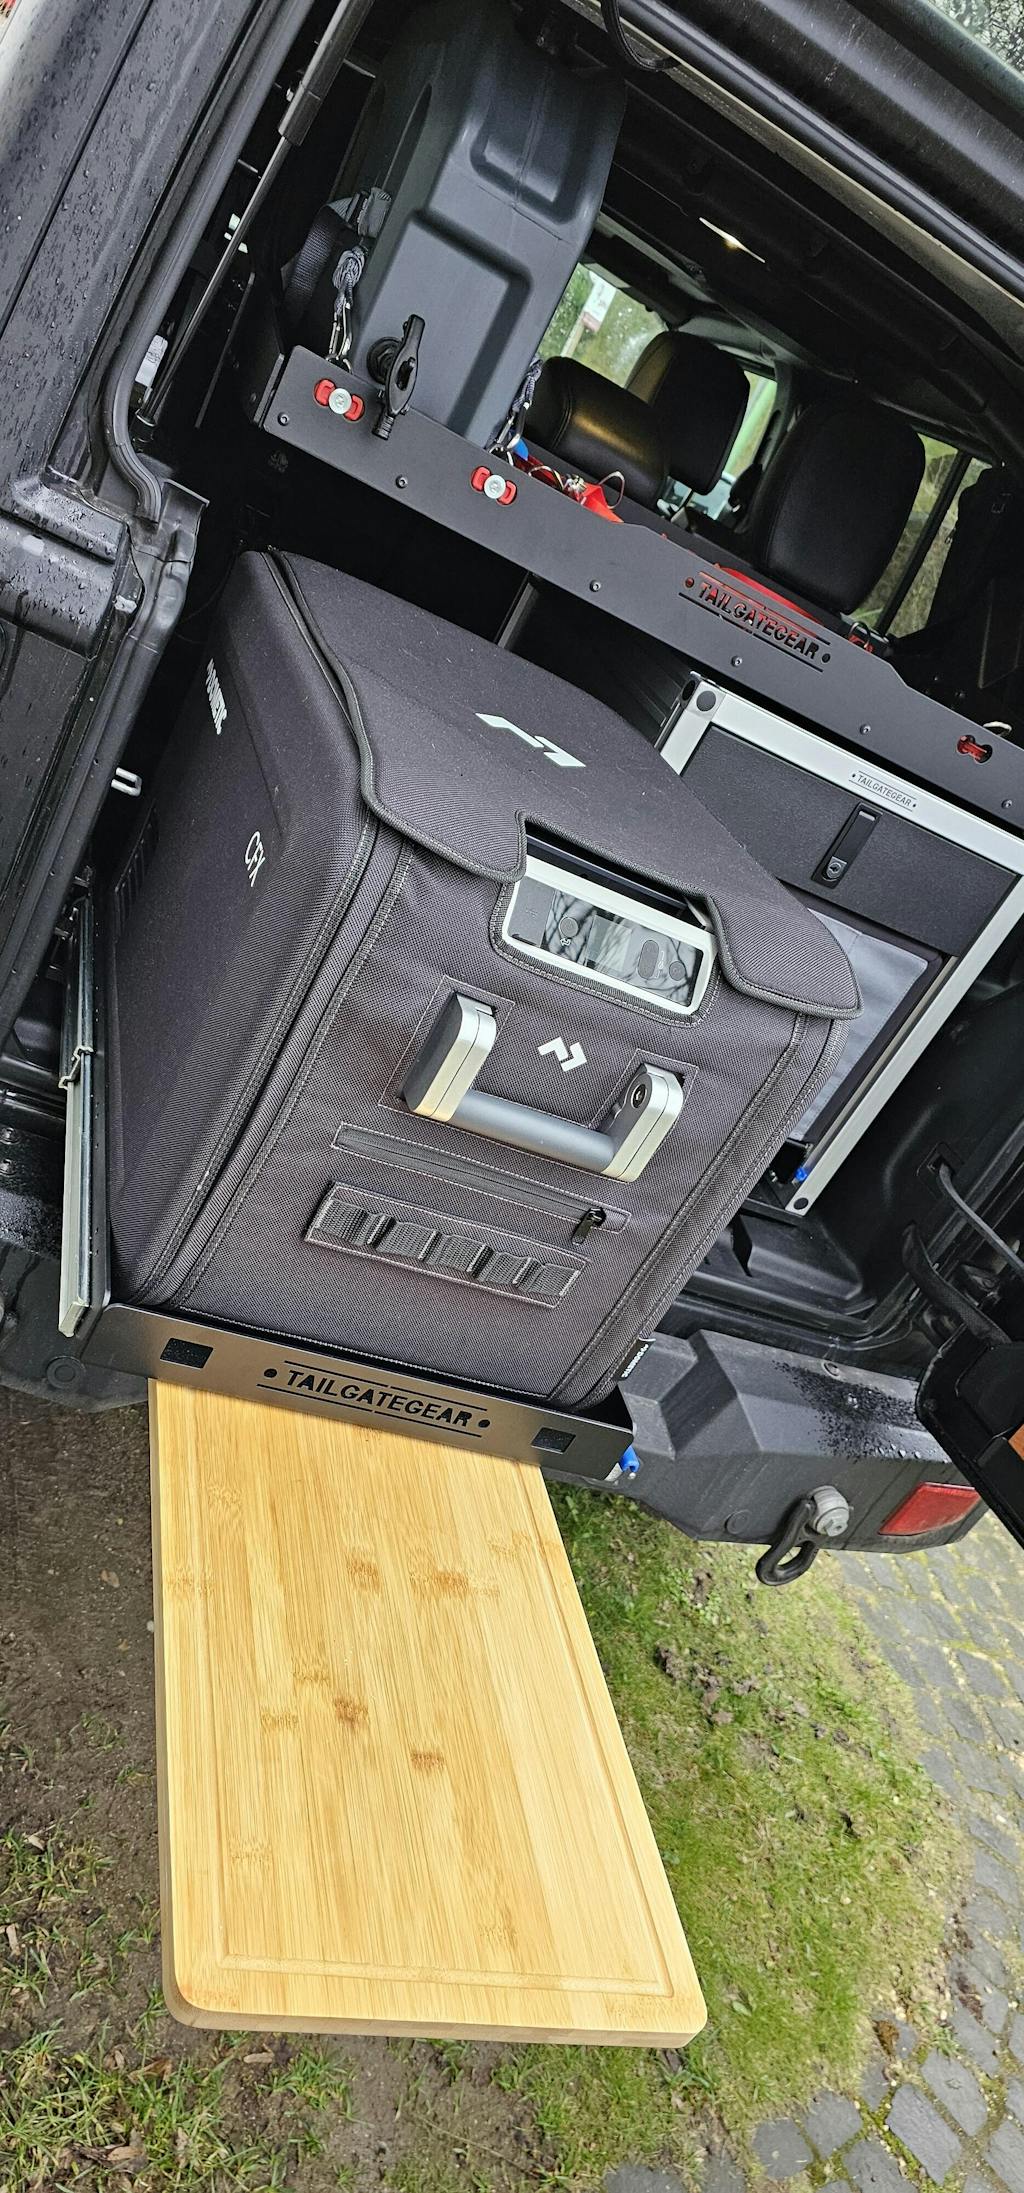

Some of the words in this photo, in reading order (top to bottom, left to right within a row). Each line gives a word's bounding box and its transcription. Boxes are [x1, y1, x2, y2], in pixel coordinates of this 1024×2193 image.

[698, 582, 820, 660] TAILGATEGEAR
[857, 774, 912, 807] TAILGATEGEAR
[245, 831, 266, 888] CFX
[287, 1369, 473, 1427] TAILGATEGEAR
